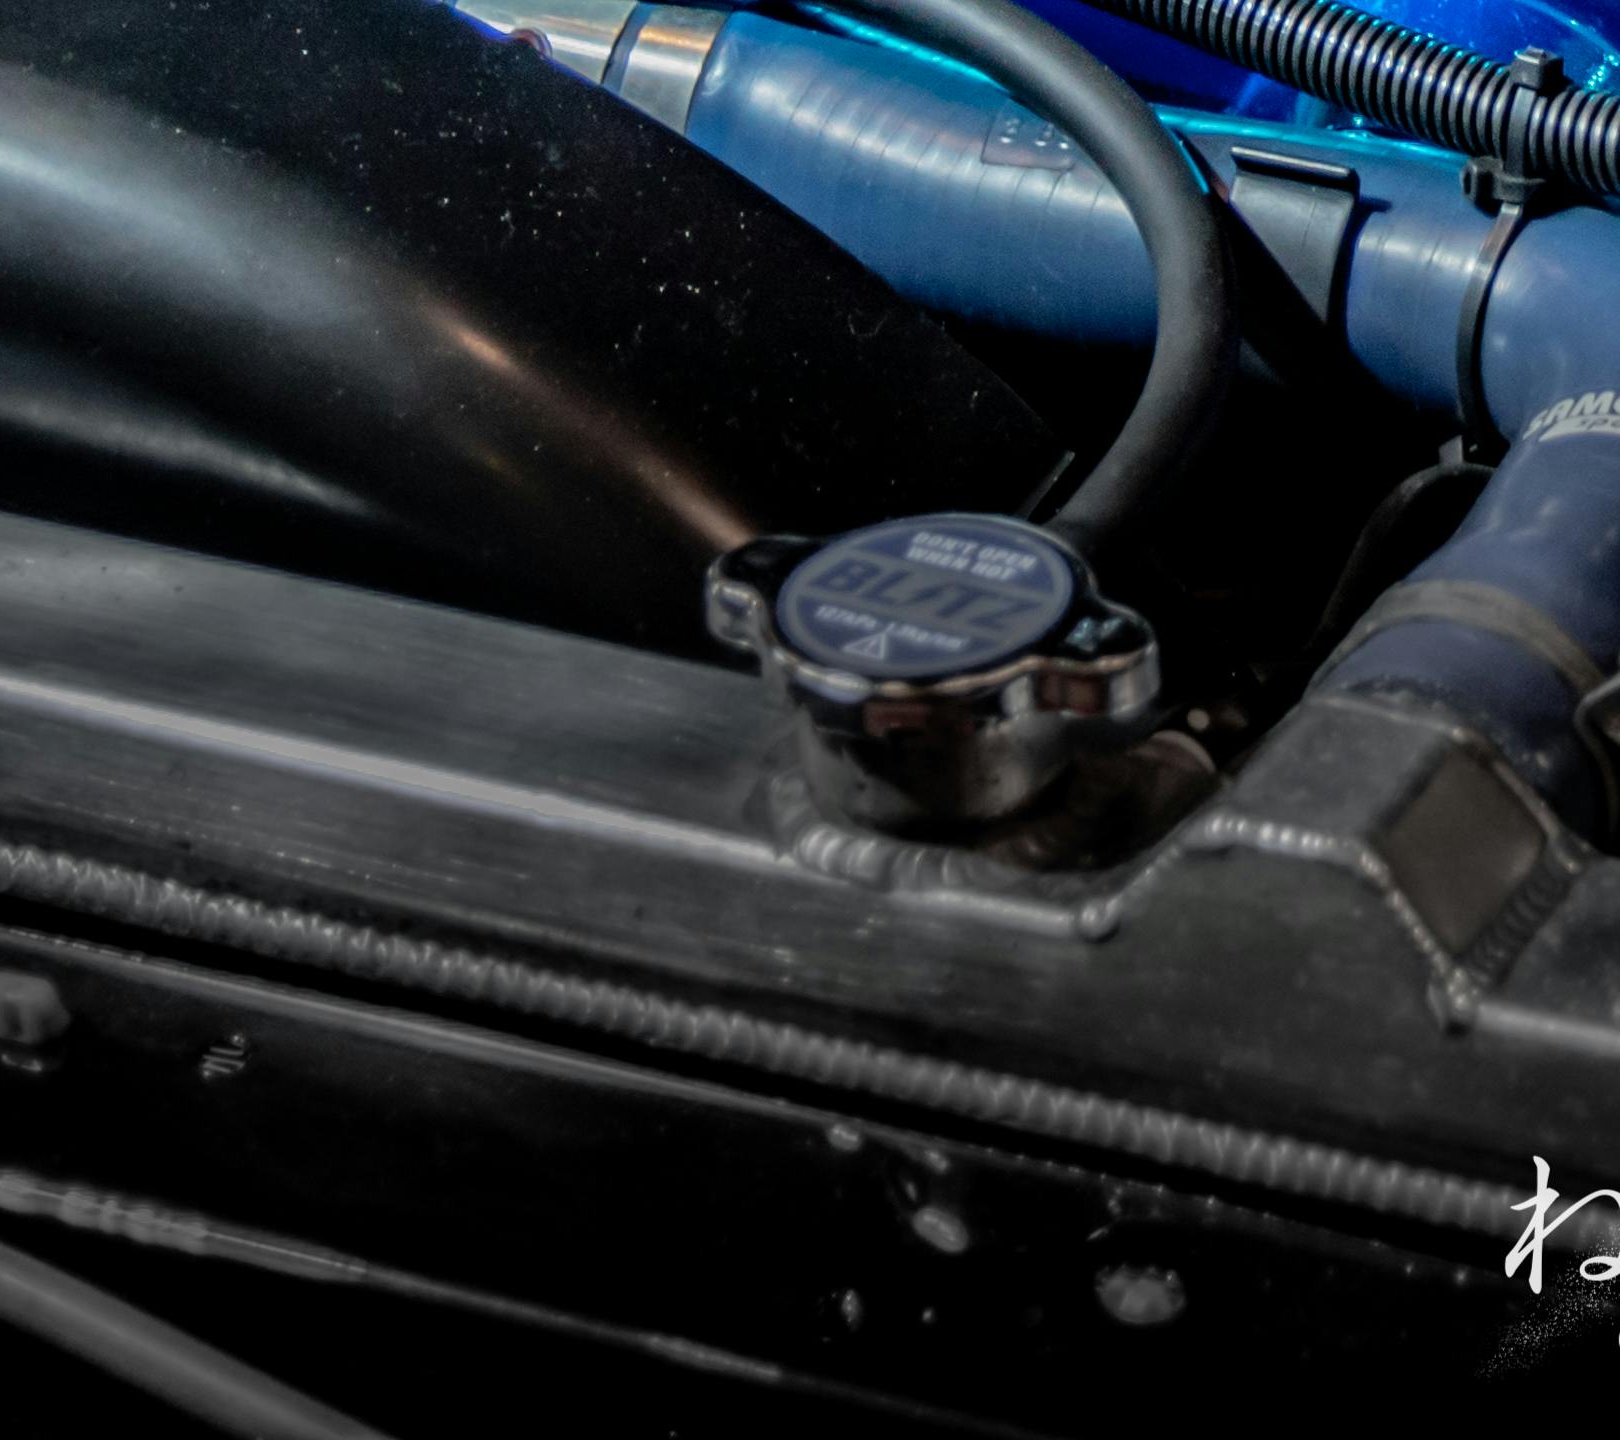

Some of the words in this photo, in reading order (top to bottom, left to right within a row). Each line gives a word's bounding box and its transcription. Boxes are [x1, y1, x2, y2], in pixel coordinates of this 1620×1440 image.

[905, 546, 972, 572] WHEN
[971, 561, 1020, 582] HOT
[911, 531, 980, 554] DON'T
[978, 545, 1039, 571] OPEN
[809, 556, 1044, 630] BLITZ
